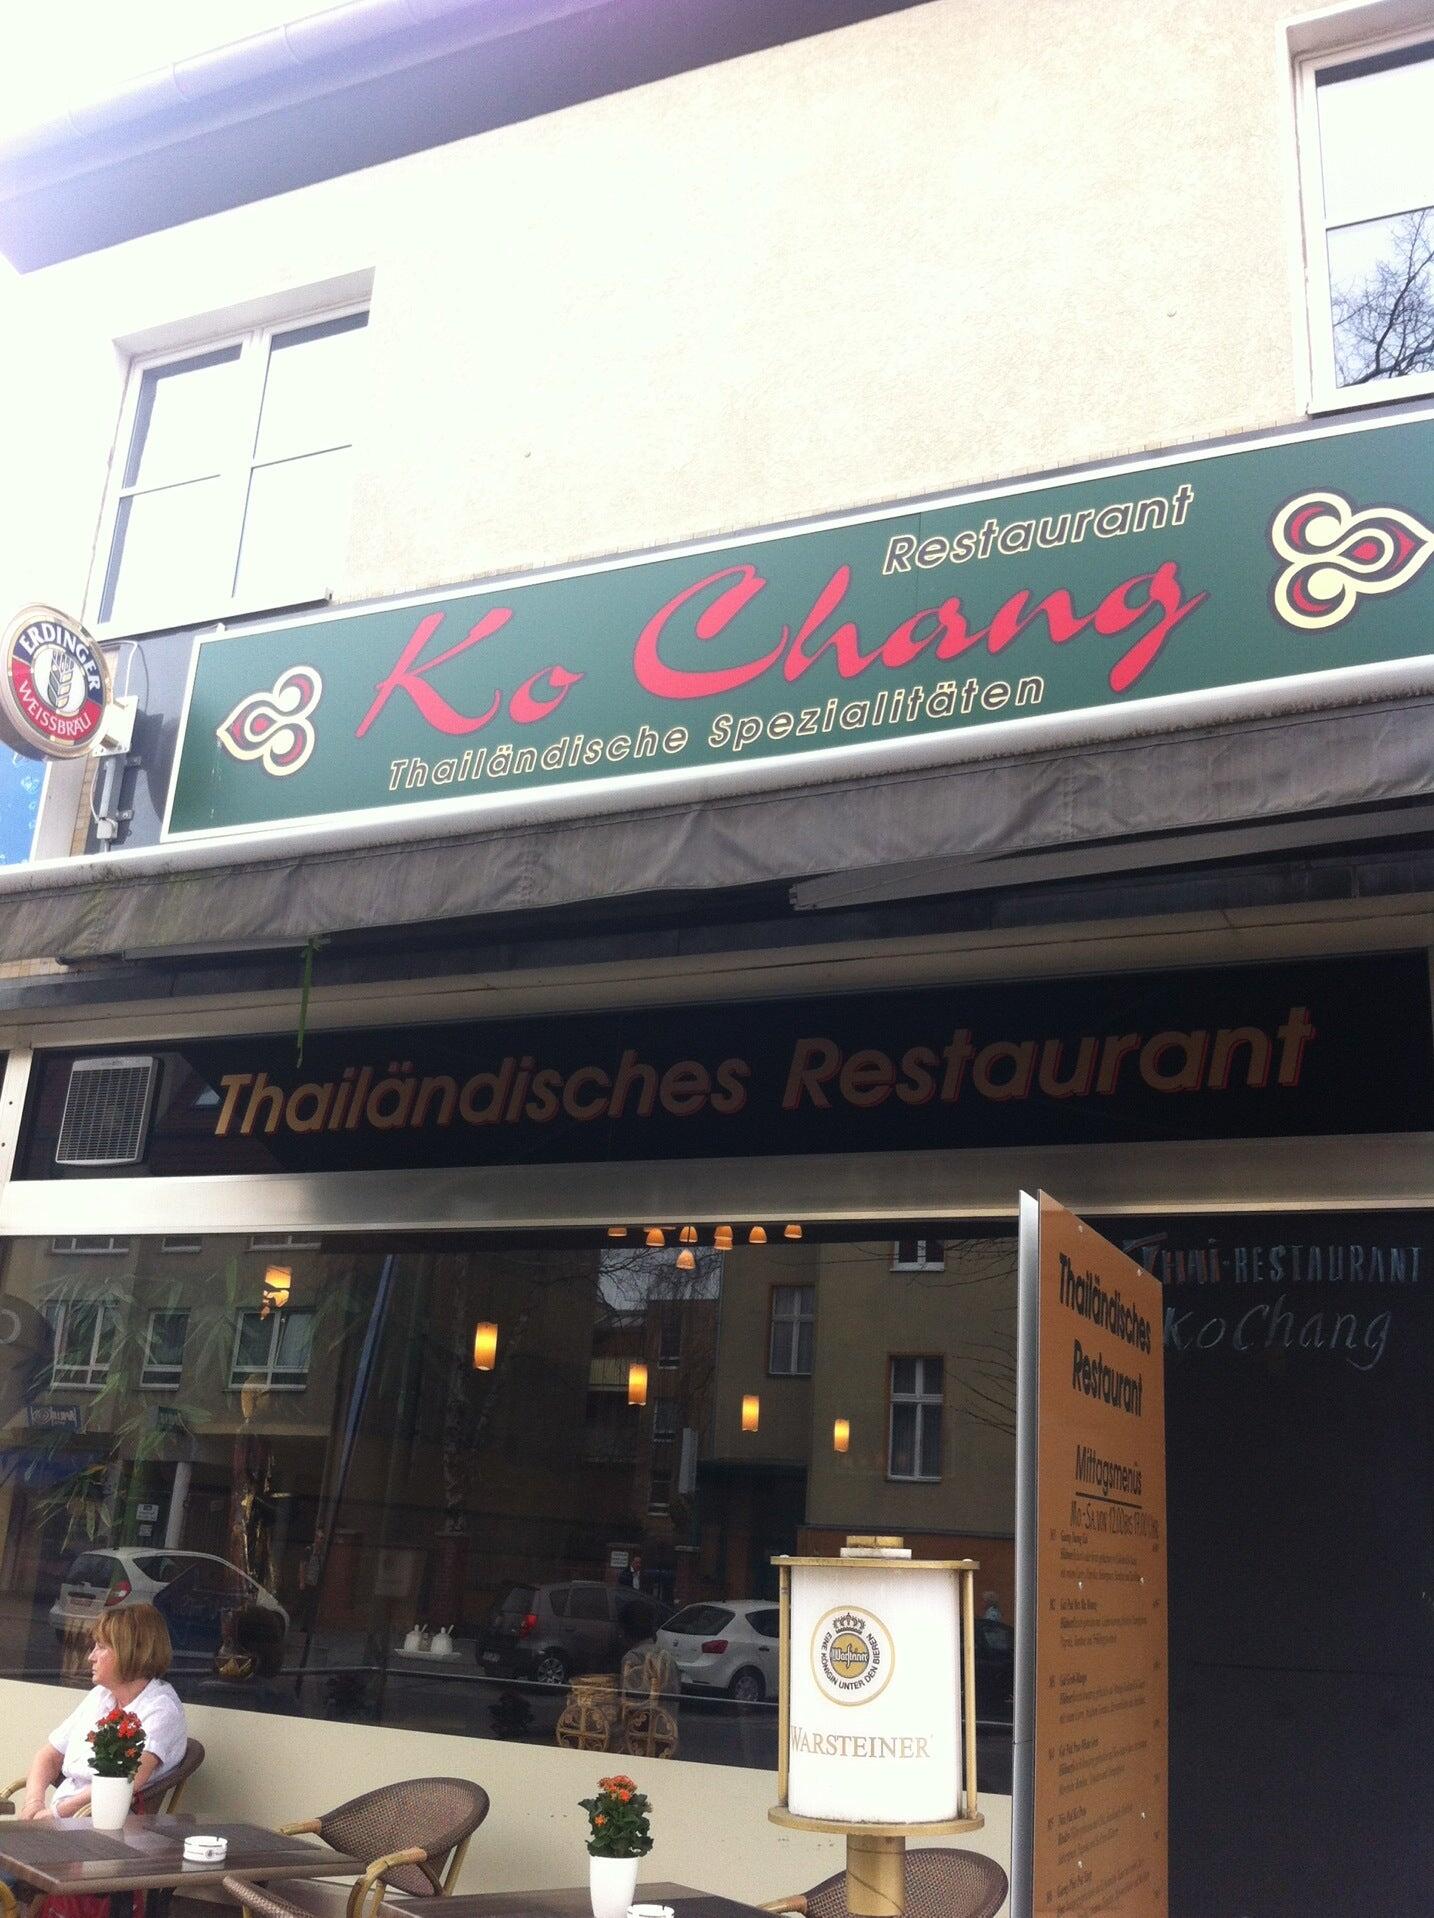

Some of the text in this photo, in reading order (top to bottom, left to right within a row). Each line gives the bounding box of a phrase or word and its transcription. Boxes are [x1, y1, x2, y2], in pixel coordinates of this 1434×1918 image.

[882, 484, 1194, 575] Restaurant
[18, 622, 101, 690] ERDINGER
[353, 561, 1211, 739] Ko Chang
[388, 674, 1045, 791] Thailändische Spezialitäten
[213, 1006, 1318, 1138] Thailändisches Restaurant
[1059, 1252, 1151, 1354] Thailändisches
[1072, 1338, 1143, 1417] Restaurant
[821, 1632, 832, 1651] EINE
[864, 1665, 878, 1683] DEN
[866, 1633, 880, 1665] BIEREN
[838, 1679, 866, 1691] UNTER
[790, 1725, 931, 1759] WARSTEINER
